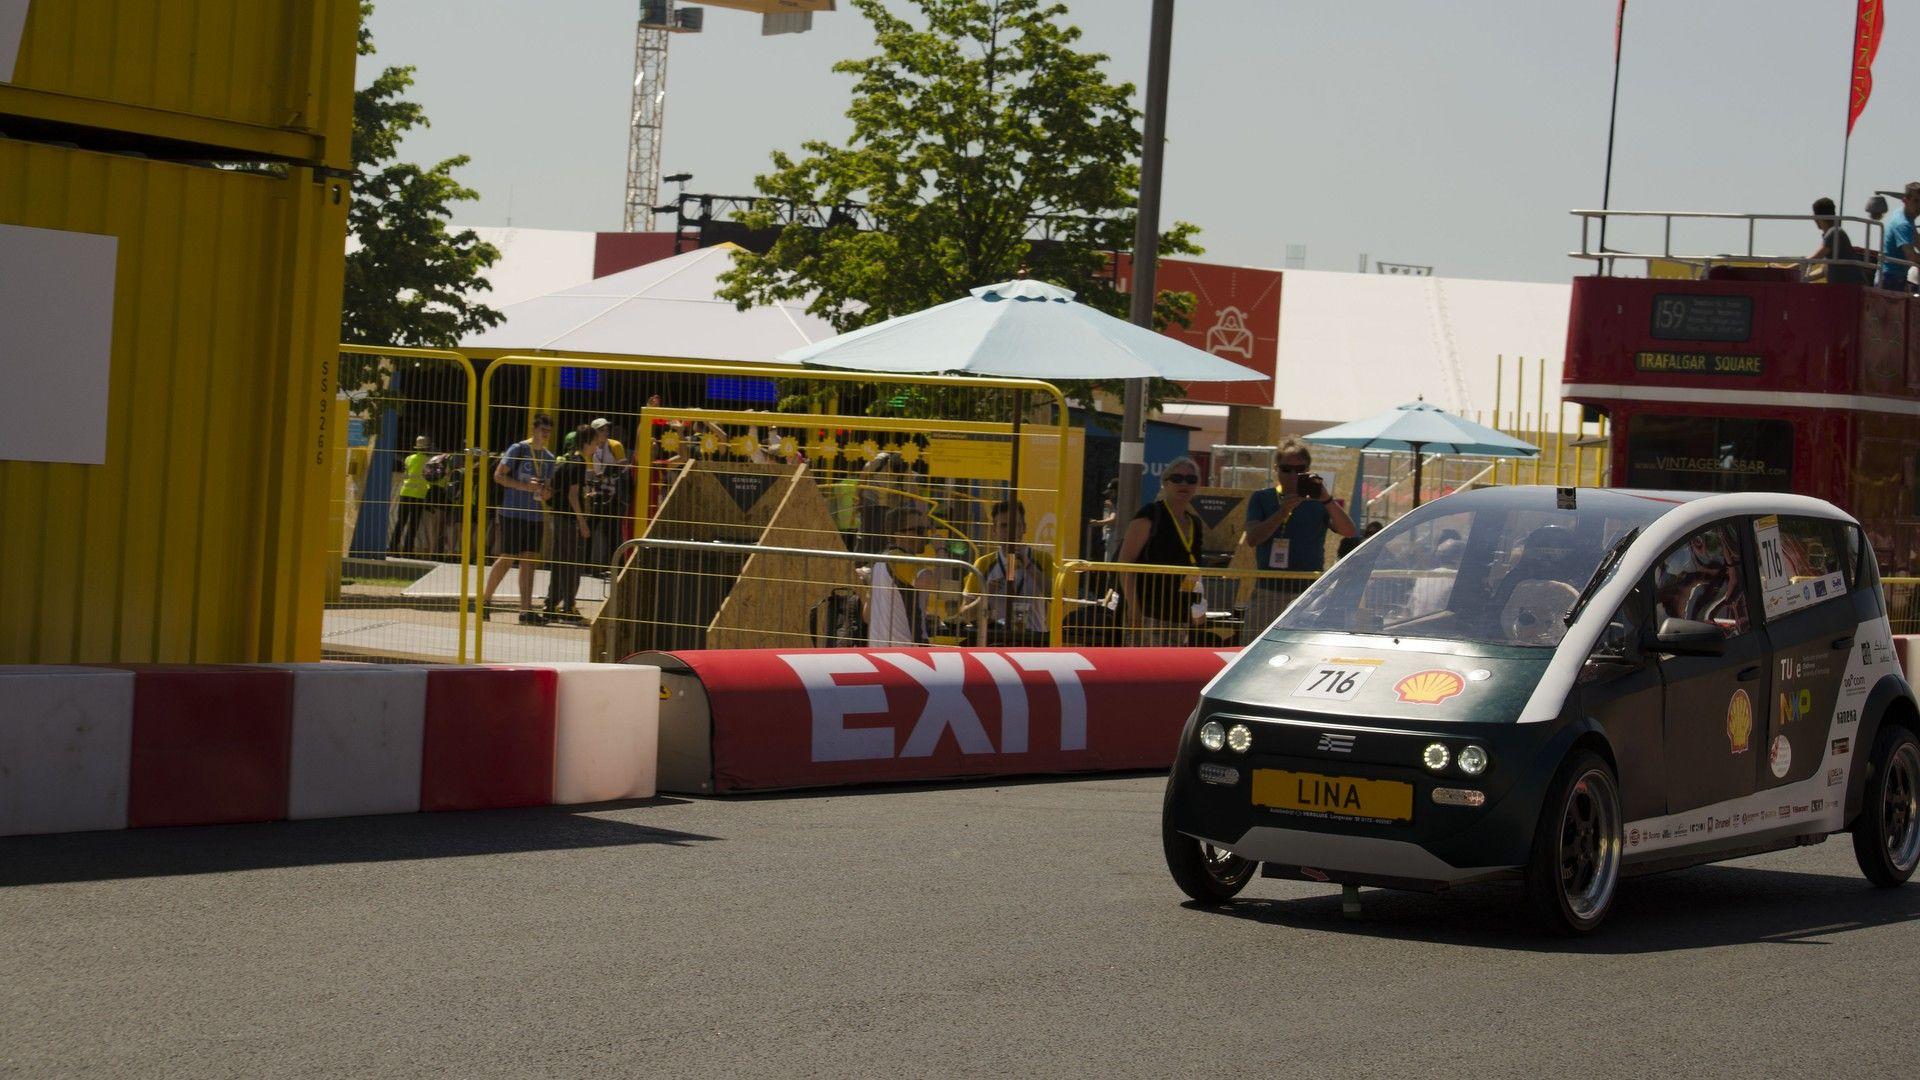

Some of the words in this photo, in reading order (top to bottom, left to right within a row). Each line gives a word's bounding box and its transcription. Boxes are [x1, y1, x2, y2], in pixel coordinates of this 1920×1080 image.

[1854, 0, 1873, 108] VINTA
[1656, 299, 1686, 328] 159
[1639, 352, 1706, 371] TRAFALGAR
[1714, 355, 1762, 373] SQUARE
[1761, 538, 1783, 580] 716
[1306, 669, 1360, 694] 716
[777, 652, 1096, 762] EXIT
[1779, 688, 1811, 725] NXP
[1298, 778, 1361, 810] LINA
